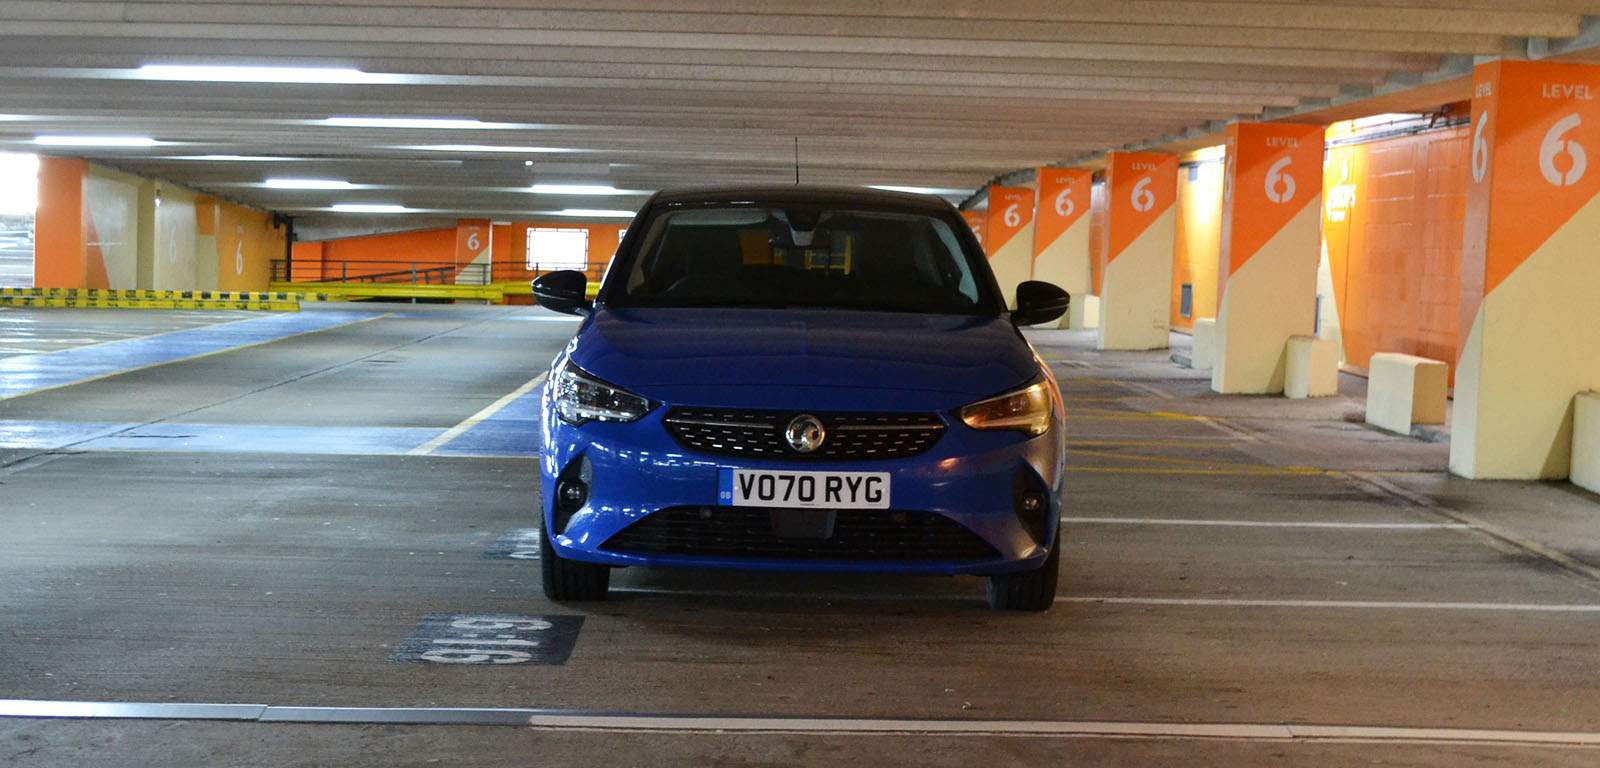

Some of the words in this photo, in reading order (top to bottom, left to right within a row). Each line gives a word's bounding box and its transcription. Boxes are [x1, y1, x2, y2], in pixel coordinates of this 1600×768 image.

[1542, 84, 1592, 100] LEVEL
[1266, 136, 1299, 149] LEVEL
[1472, 111, 1488, 184] 6
[1539, 112, 1587, 187] 6
[1132, 162, 1157, 171] LEVEL
[1264, 155, 1296, 204] 6
[1055, 188, 1074, 217] 6
[1131, 176, 1155, 213] 6
[1004, 203, 1020, 227] 6
[467, 232, 480, 250] 6
[236, 239, 243, 275] 6
[825, 476, 882, 503] RYG
